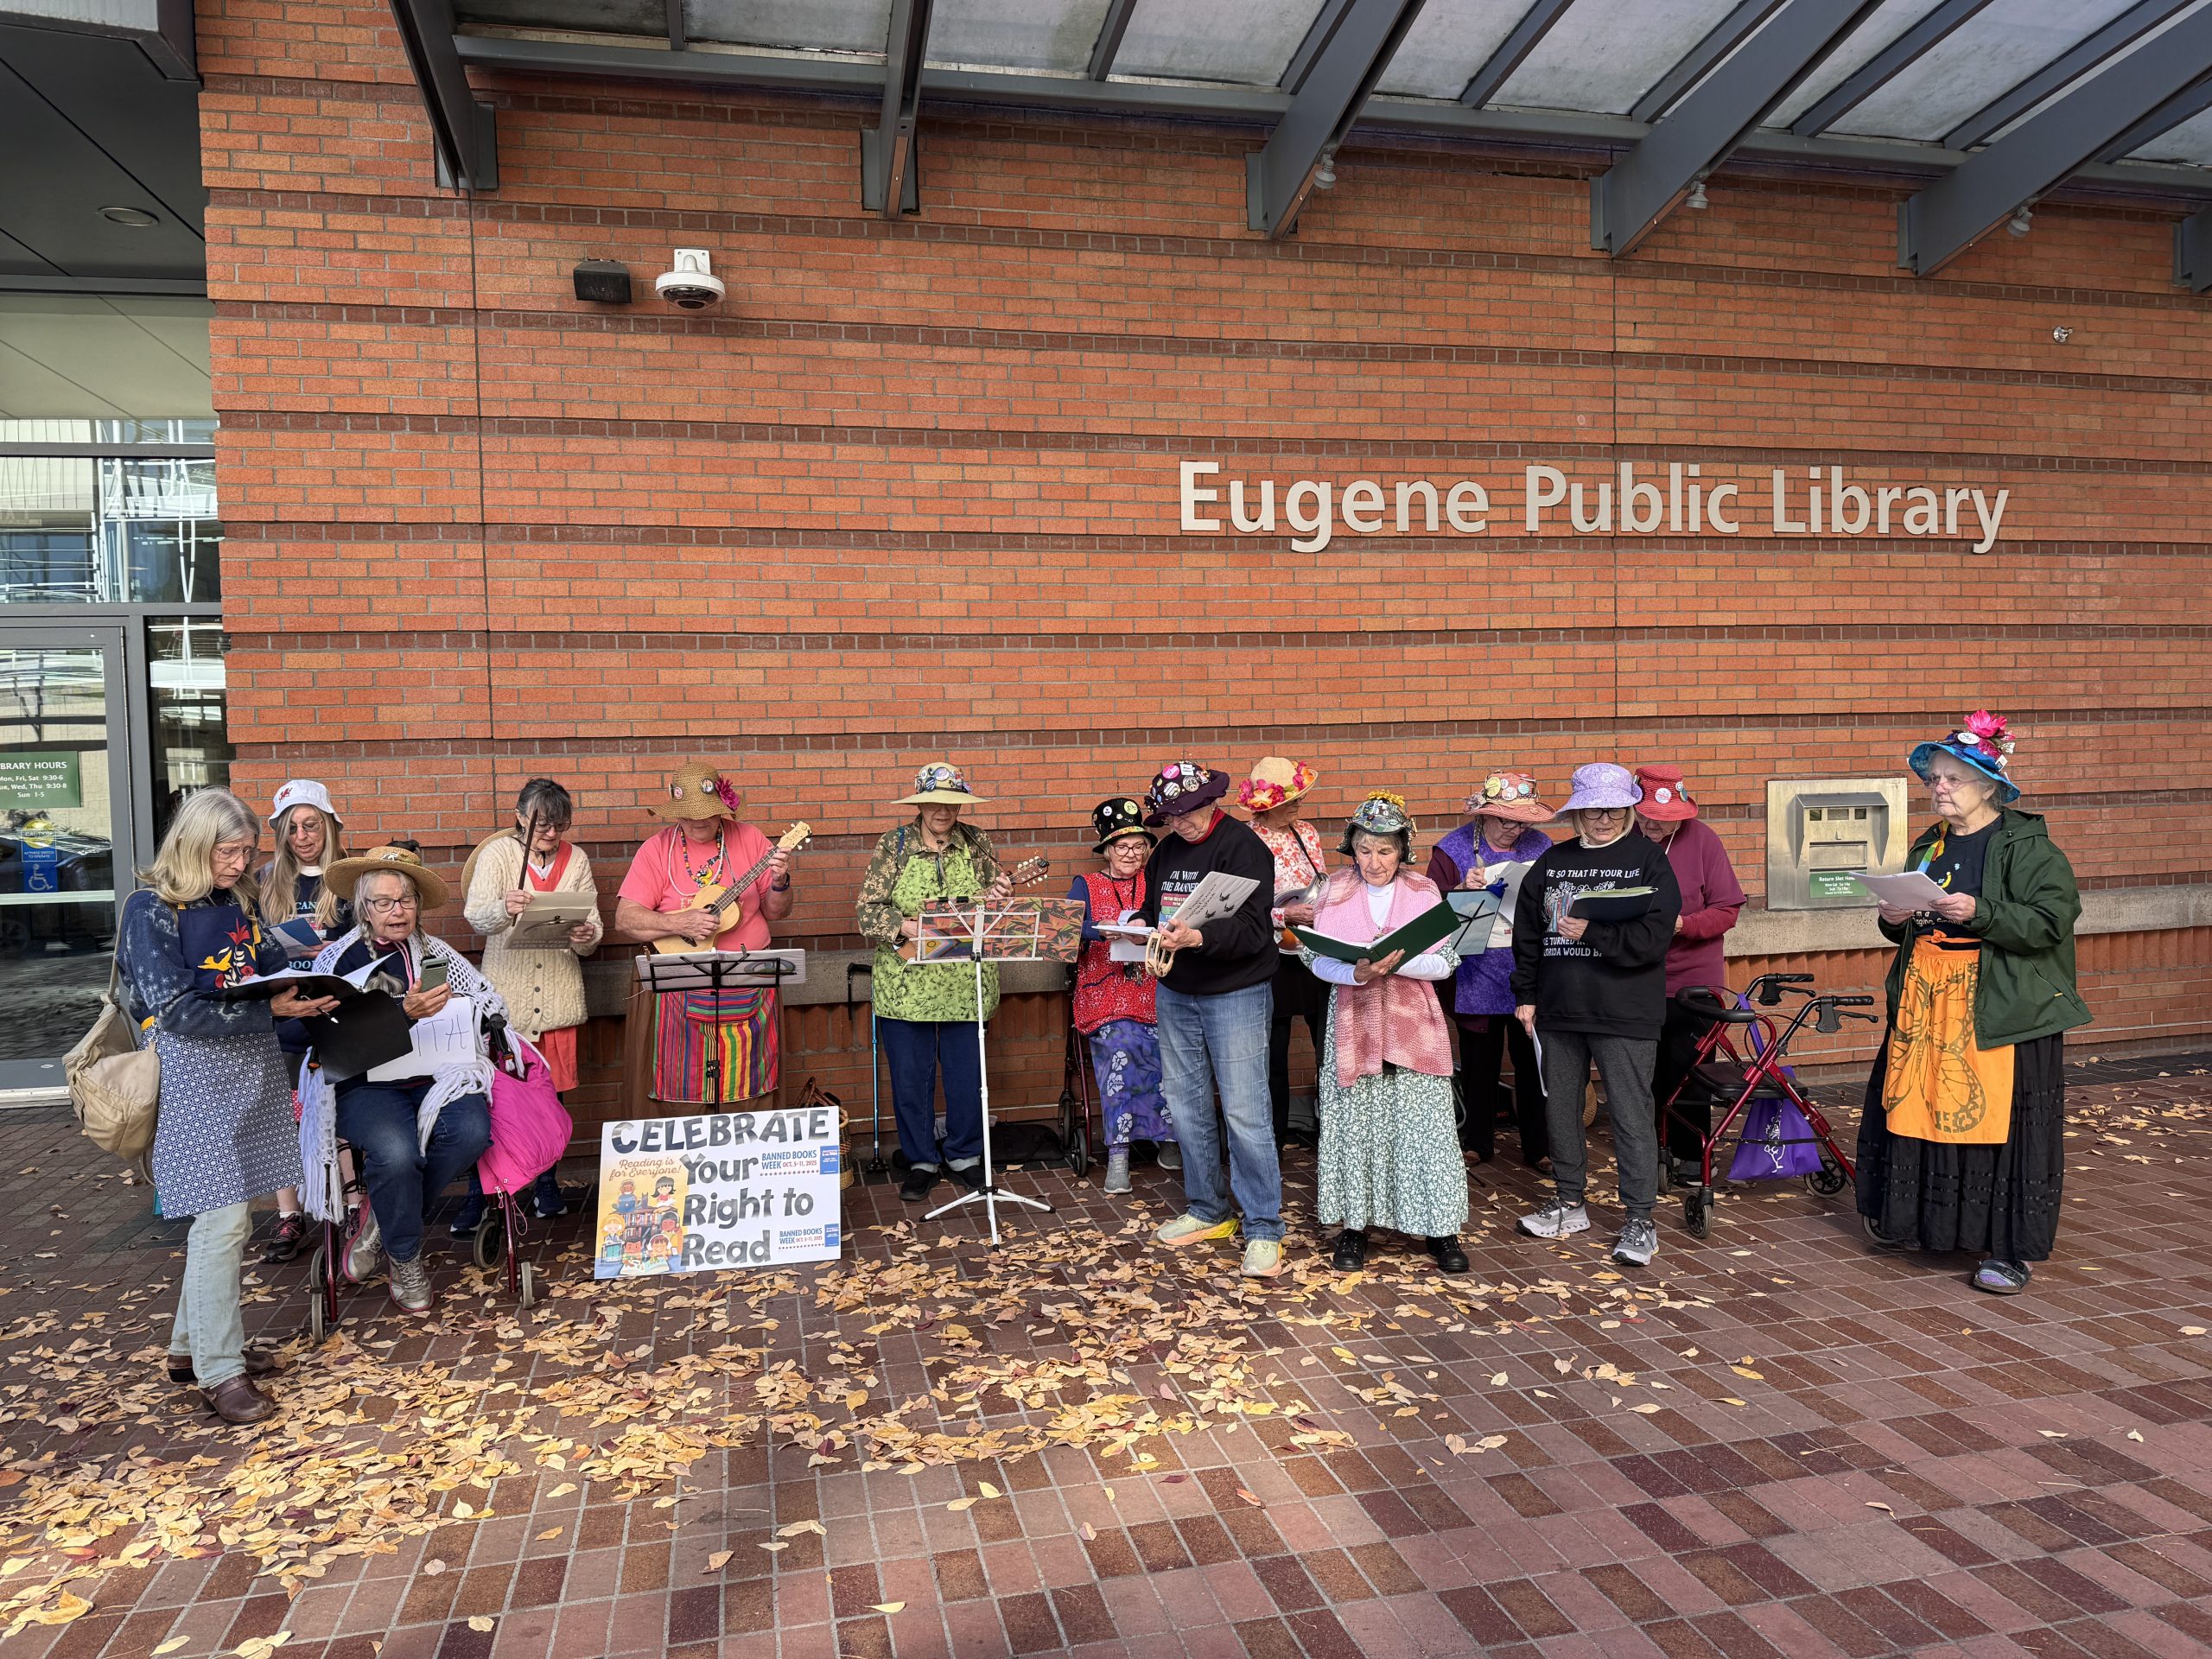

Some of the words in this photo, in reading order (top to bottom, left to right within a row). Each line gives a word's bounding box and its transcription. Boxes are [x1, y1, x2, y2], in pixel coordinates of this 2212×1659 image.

[1179, 460, 1490, 554] Eugene
[1525, 461, 1739, 534] Public
[1770, 466, 2011, 555] Library
[1183, 871, 1199, 880] WITH
[1556, 869, 1566, 879] SO
[1567, 869, 1588, 878] THAT
[1589, 868, 1599, 877] IF
[1599, 869, 1623, 878] YOUR
[1624, 868, 1641, 879] LIFE
[1161, 881, 1174, 892] THE
[1563, 947, 1591, 957] WOULD
[611, 1109, 830, 1154] CELEBRATE
[761, 1152, 791, 1161] BANNED
[792, 1150, 817, 1160] BOOKS
[619, 1158, 664, 1170] Reading
[679, 1153, 759, 1185] Your
[761, 1160, 781, 1169] WEEK
[609, 1168, 627, 1182] for
[629, 1165, 682, 1179] Everyone!
[682, 1187, 774, 1230] Right
[783, 1187, 814, 1217] to
[680, 1230, 772, 1267] Read
